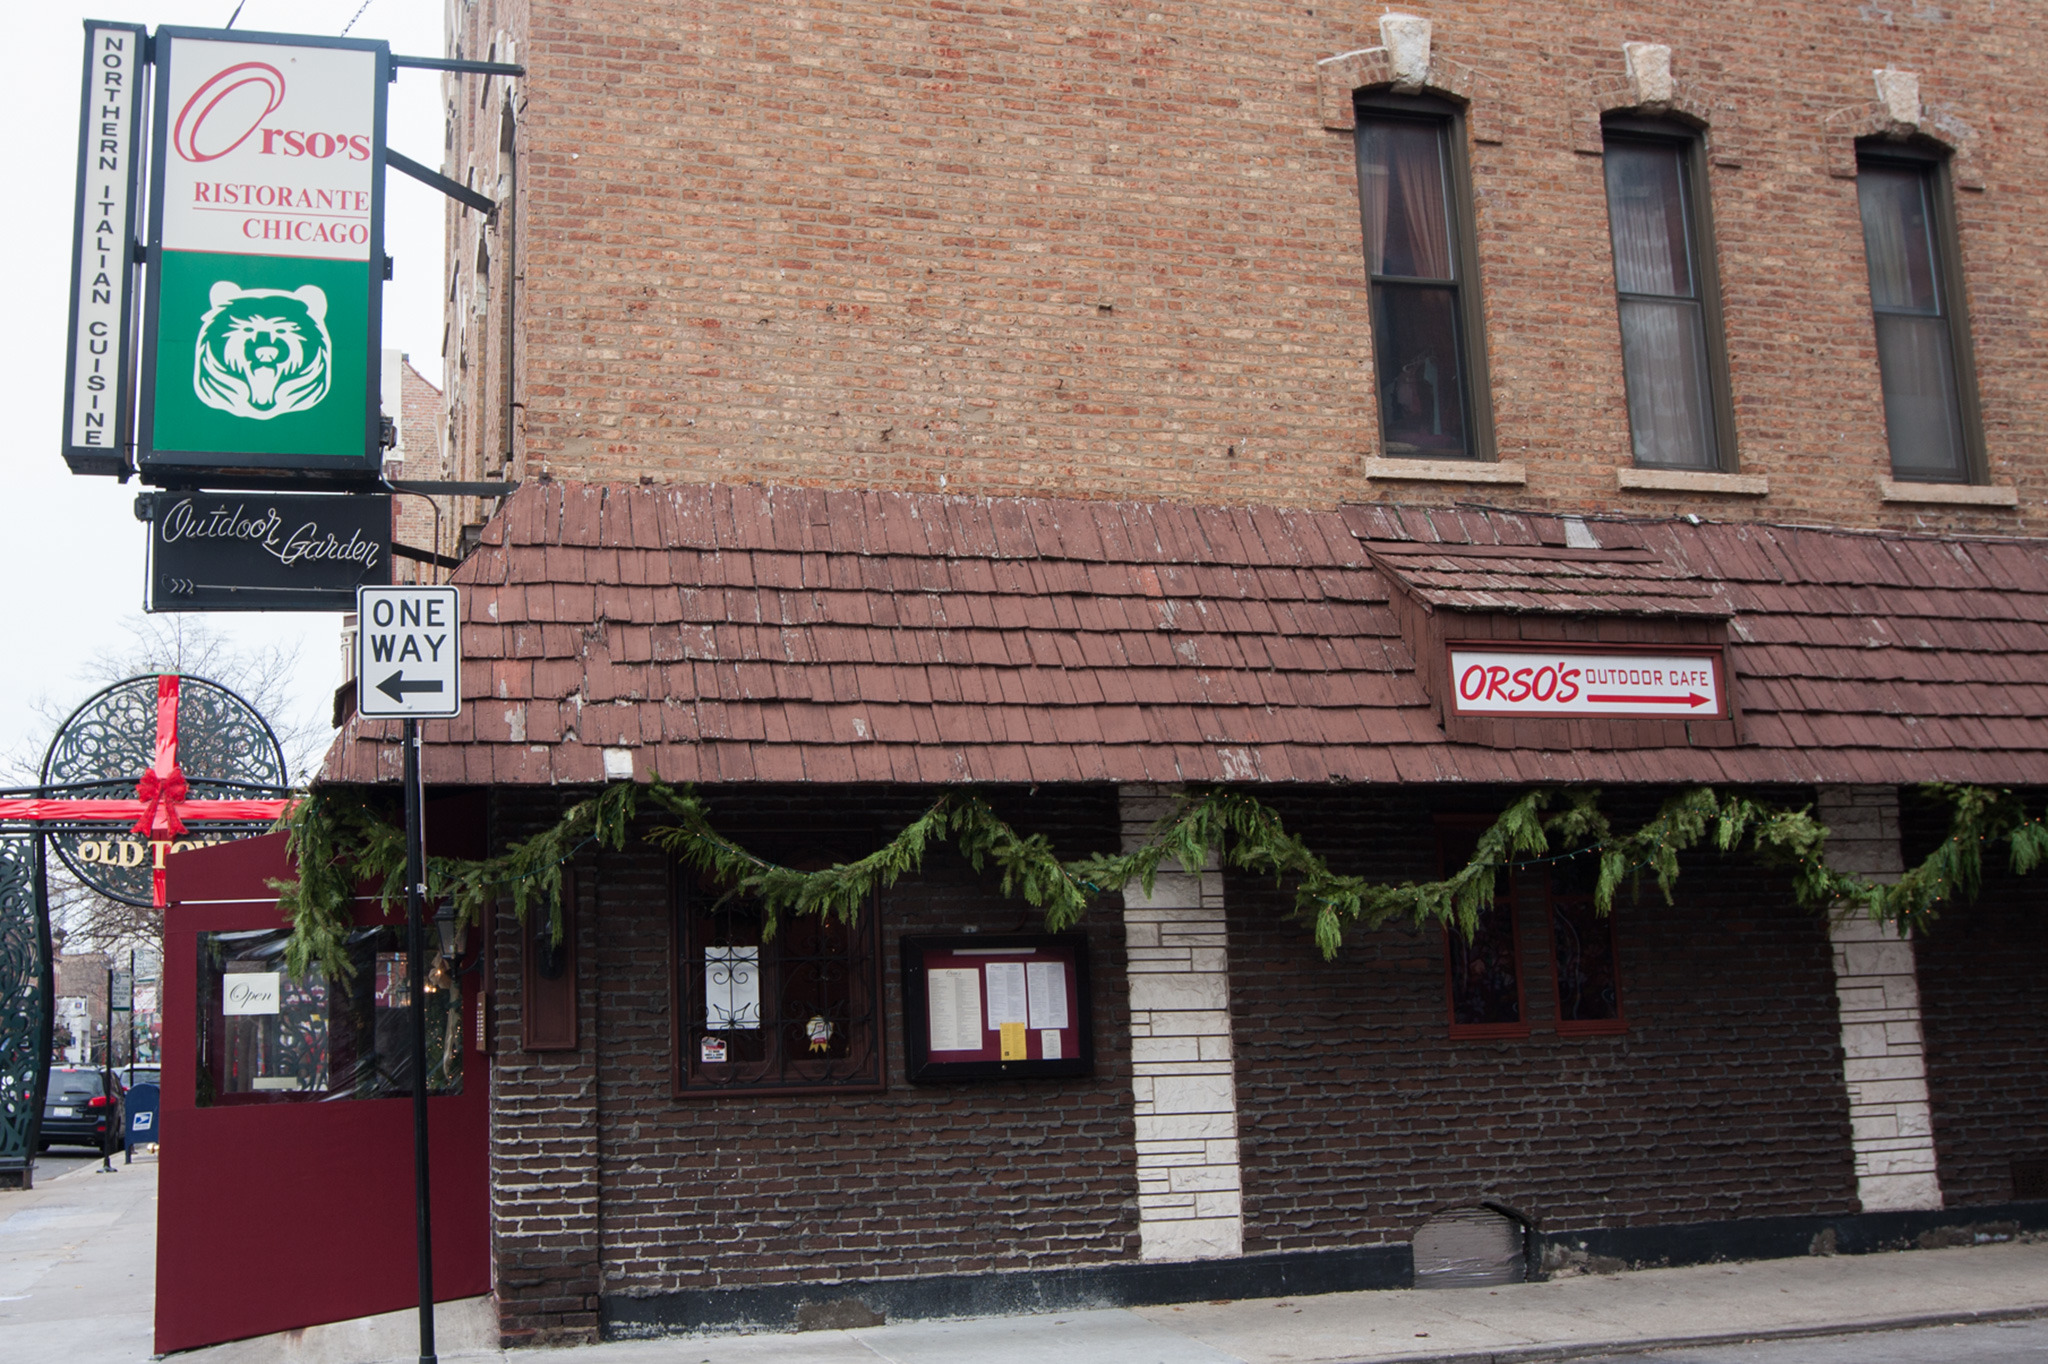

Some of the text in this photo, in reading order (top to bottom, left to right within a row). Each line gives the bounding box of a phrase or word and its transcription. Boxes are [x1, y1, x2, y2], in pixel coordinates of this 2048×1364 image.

[193, 181, 369, 211] RISTORANTE
[85, 37, 123, 446] NORTHERN ITALIAN CUISINE
[242, 218, 369, 245] CHICAGO
[162, 498, 281, 545] Outdoor
[264, 522, 379, 569] Garden
[373, 599, 445, 627] ONE
[371, 634, 447, 663] WAY
[1460, 662, 1709, 703] ORSO'S OUTDOOR CAFE
[78, 840, 144, 868] OLD
[230, 982, 272, 1009] Open
